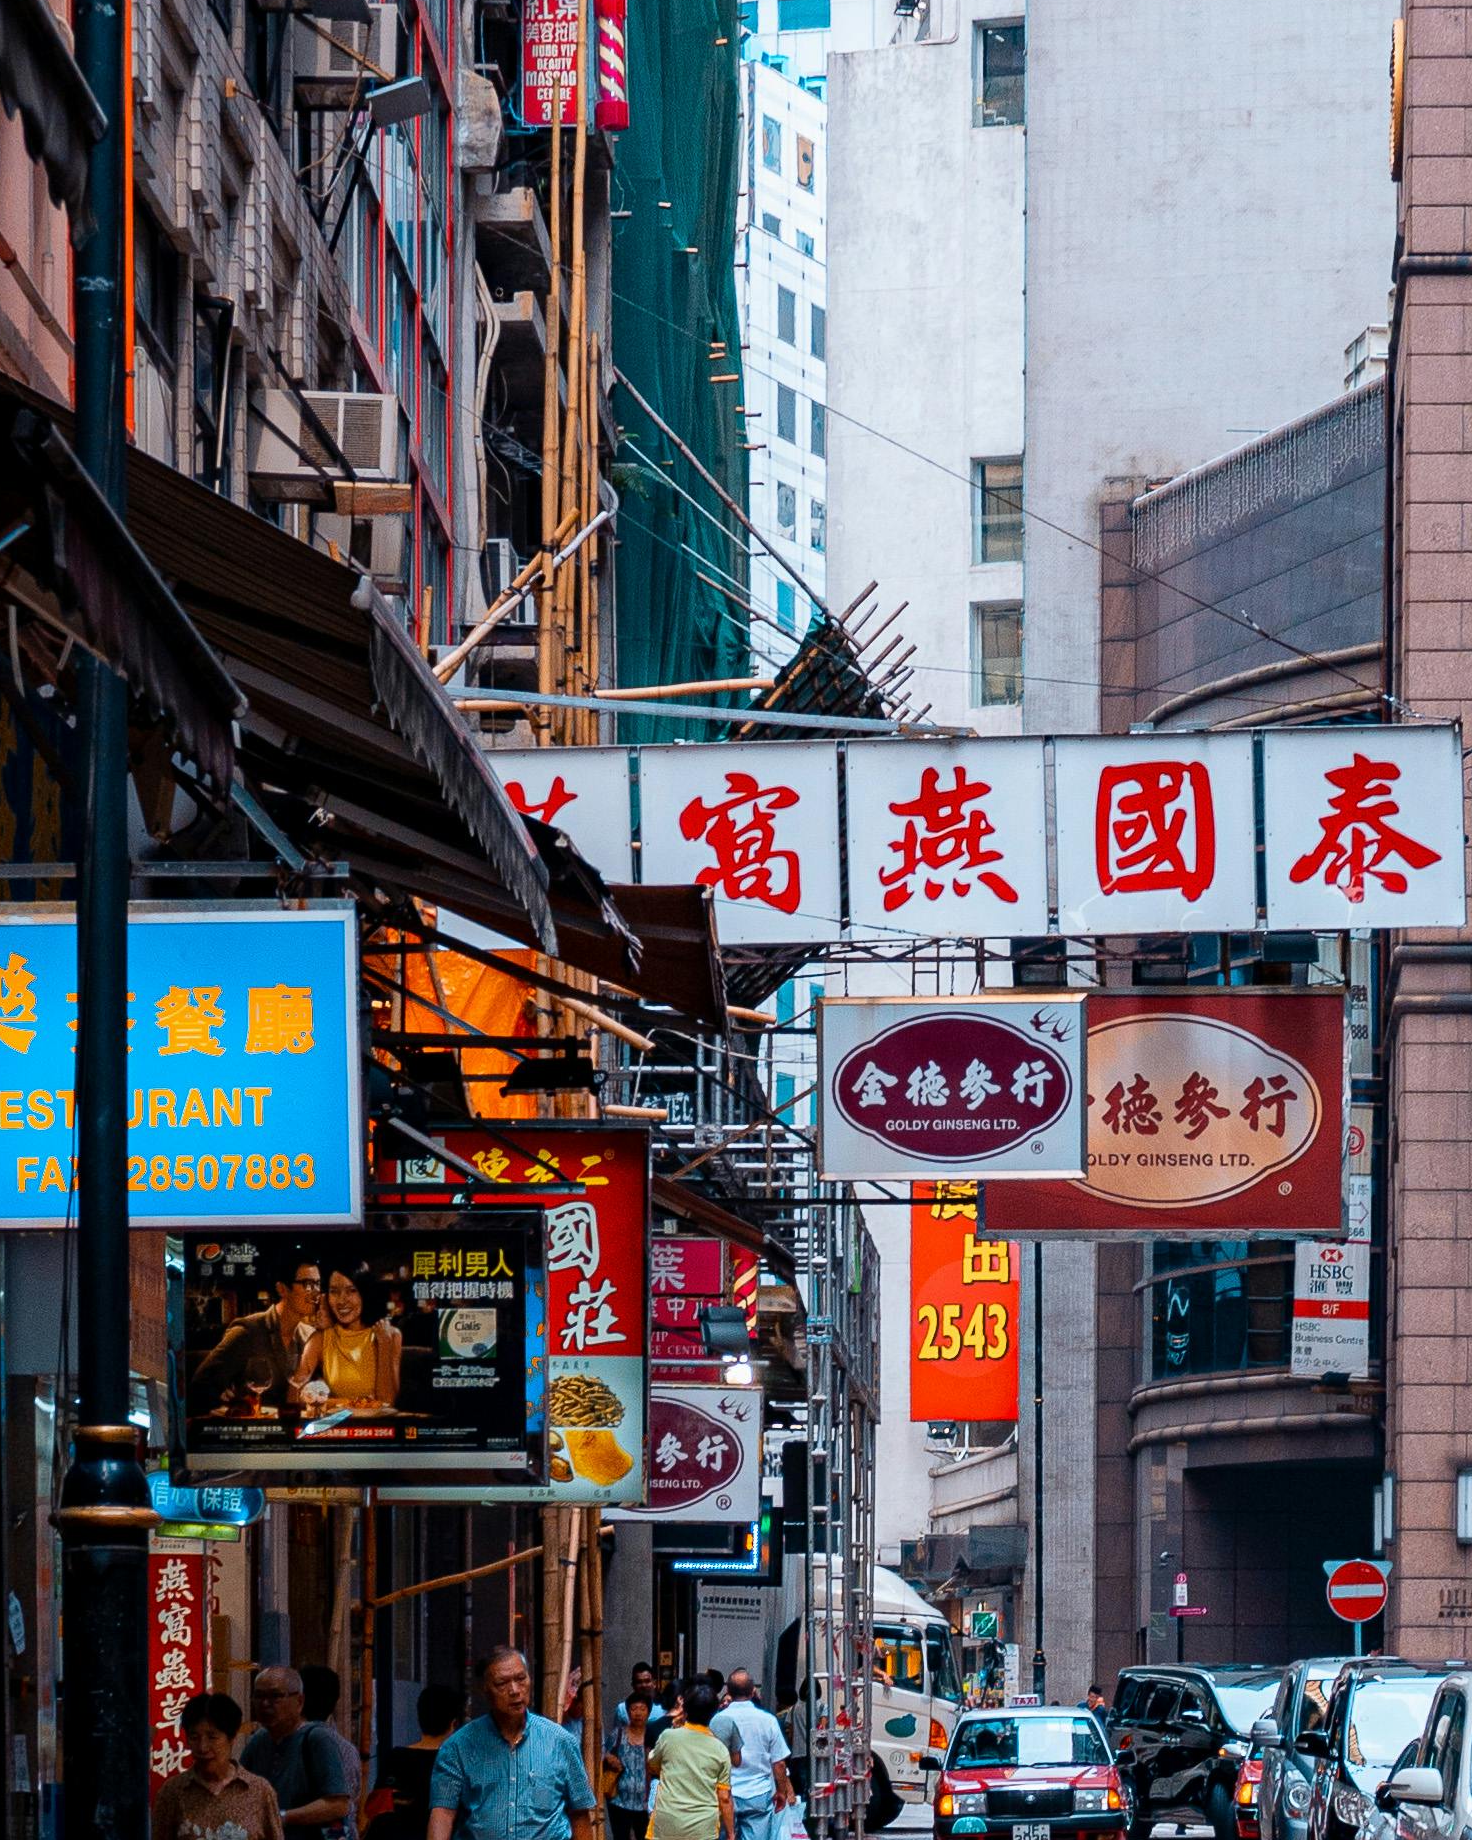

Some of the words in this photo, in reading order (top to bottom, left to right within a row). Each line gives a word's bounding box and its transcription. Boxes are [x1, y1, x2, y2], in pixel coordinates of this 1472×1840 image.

[561, 44, 576, 56] YIP
[537, 57, 571, 70] BEAUTY
[526, 71, 576, 86] MASSAG
[537, 87, 572, 100] CENRE
[542, 102, 567, 121] 3F
[66, 983, 316, 1057] 餐廳
[1087, 1071, 1298, 1141] 德參行
[885, 1119, 929, 1132] GOLDY
[932, 1119, 991, 1131] GINSENG
[993, 1119, 1020, 1131] LTD.
[1087, 1153, 1129, 1167] OLDY
[1137, 1153, 1213, 1167] GINSENG
[1219, 1153, 1255, 1167] LTD.
[127, 1153, 316, 1192] 28507883
[412, 1249, 514, 1280] 犀利男人
[1310, 1264, 1354, 1279] HSBC
[412, 1281, 514, 1299] 懂得把握時機
[1322, 1303, 1340, 1315] 8/F
[454, 1321, 481, 1331] Cialis
[917, 1303, 1010, 1360] 2543
[1295, 1322, 1321, 1332] HSBC
[1295, 1334, 1334, 1344] Business
[650, 1479, 680, 1489] SENG
[682, 1479, 704, 1489] LTD.
[1012, 1696, 1038, 1706] TAXI
